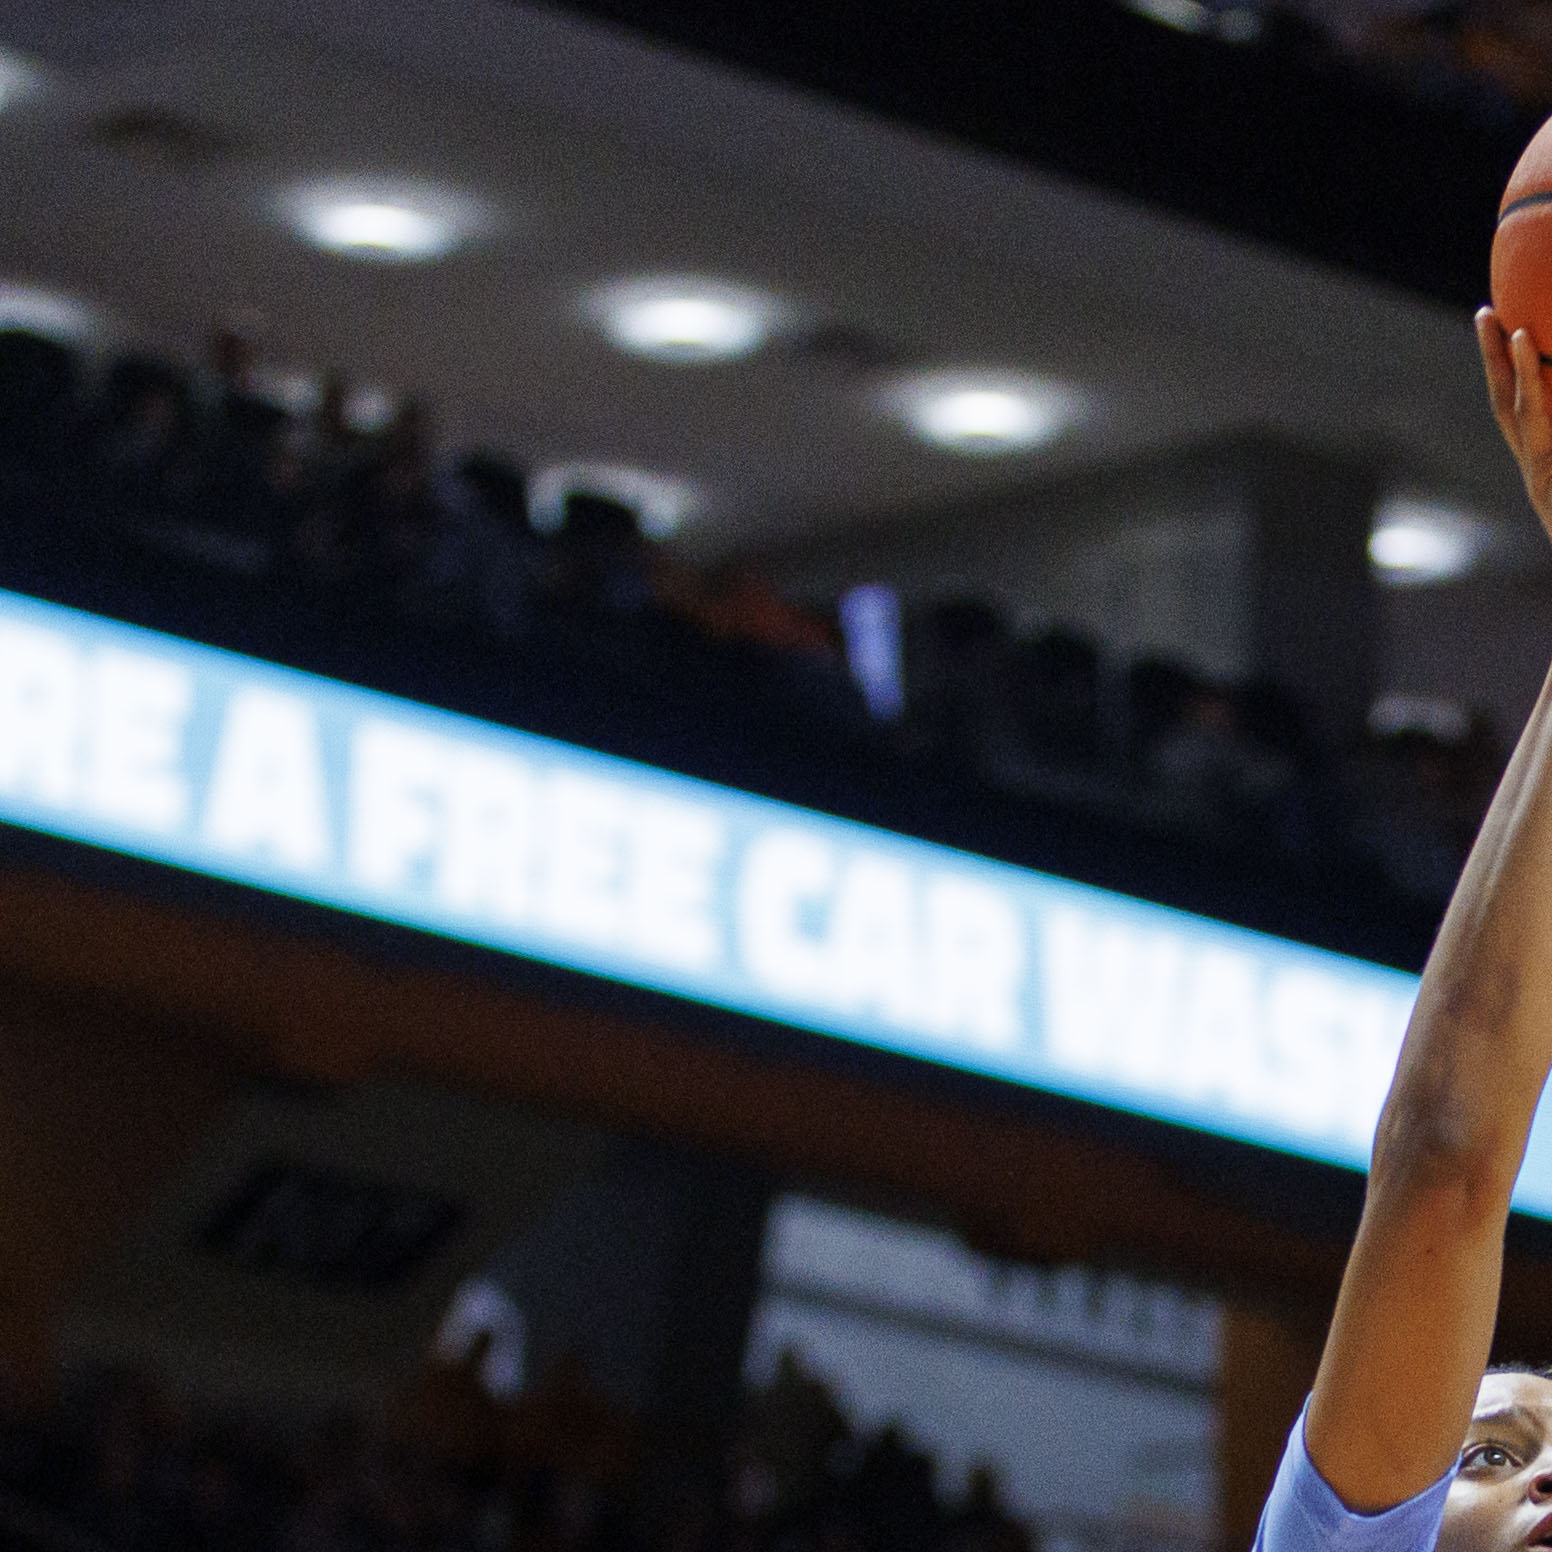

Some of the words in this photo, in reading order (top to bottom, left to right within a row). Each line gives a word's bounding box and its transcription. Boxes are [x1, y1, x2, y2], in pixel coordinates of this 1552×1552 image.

[202, 680, 330, 872] A
[349, 716, 720, 970] FREE
[740, 824, 1023, 1054] CAR
